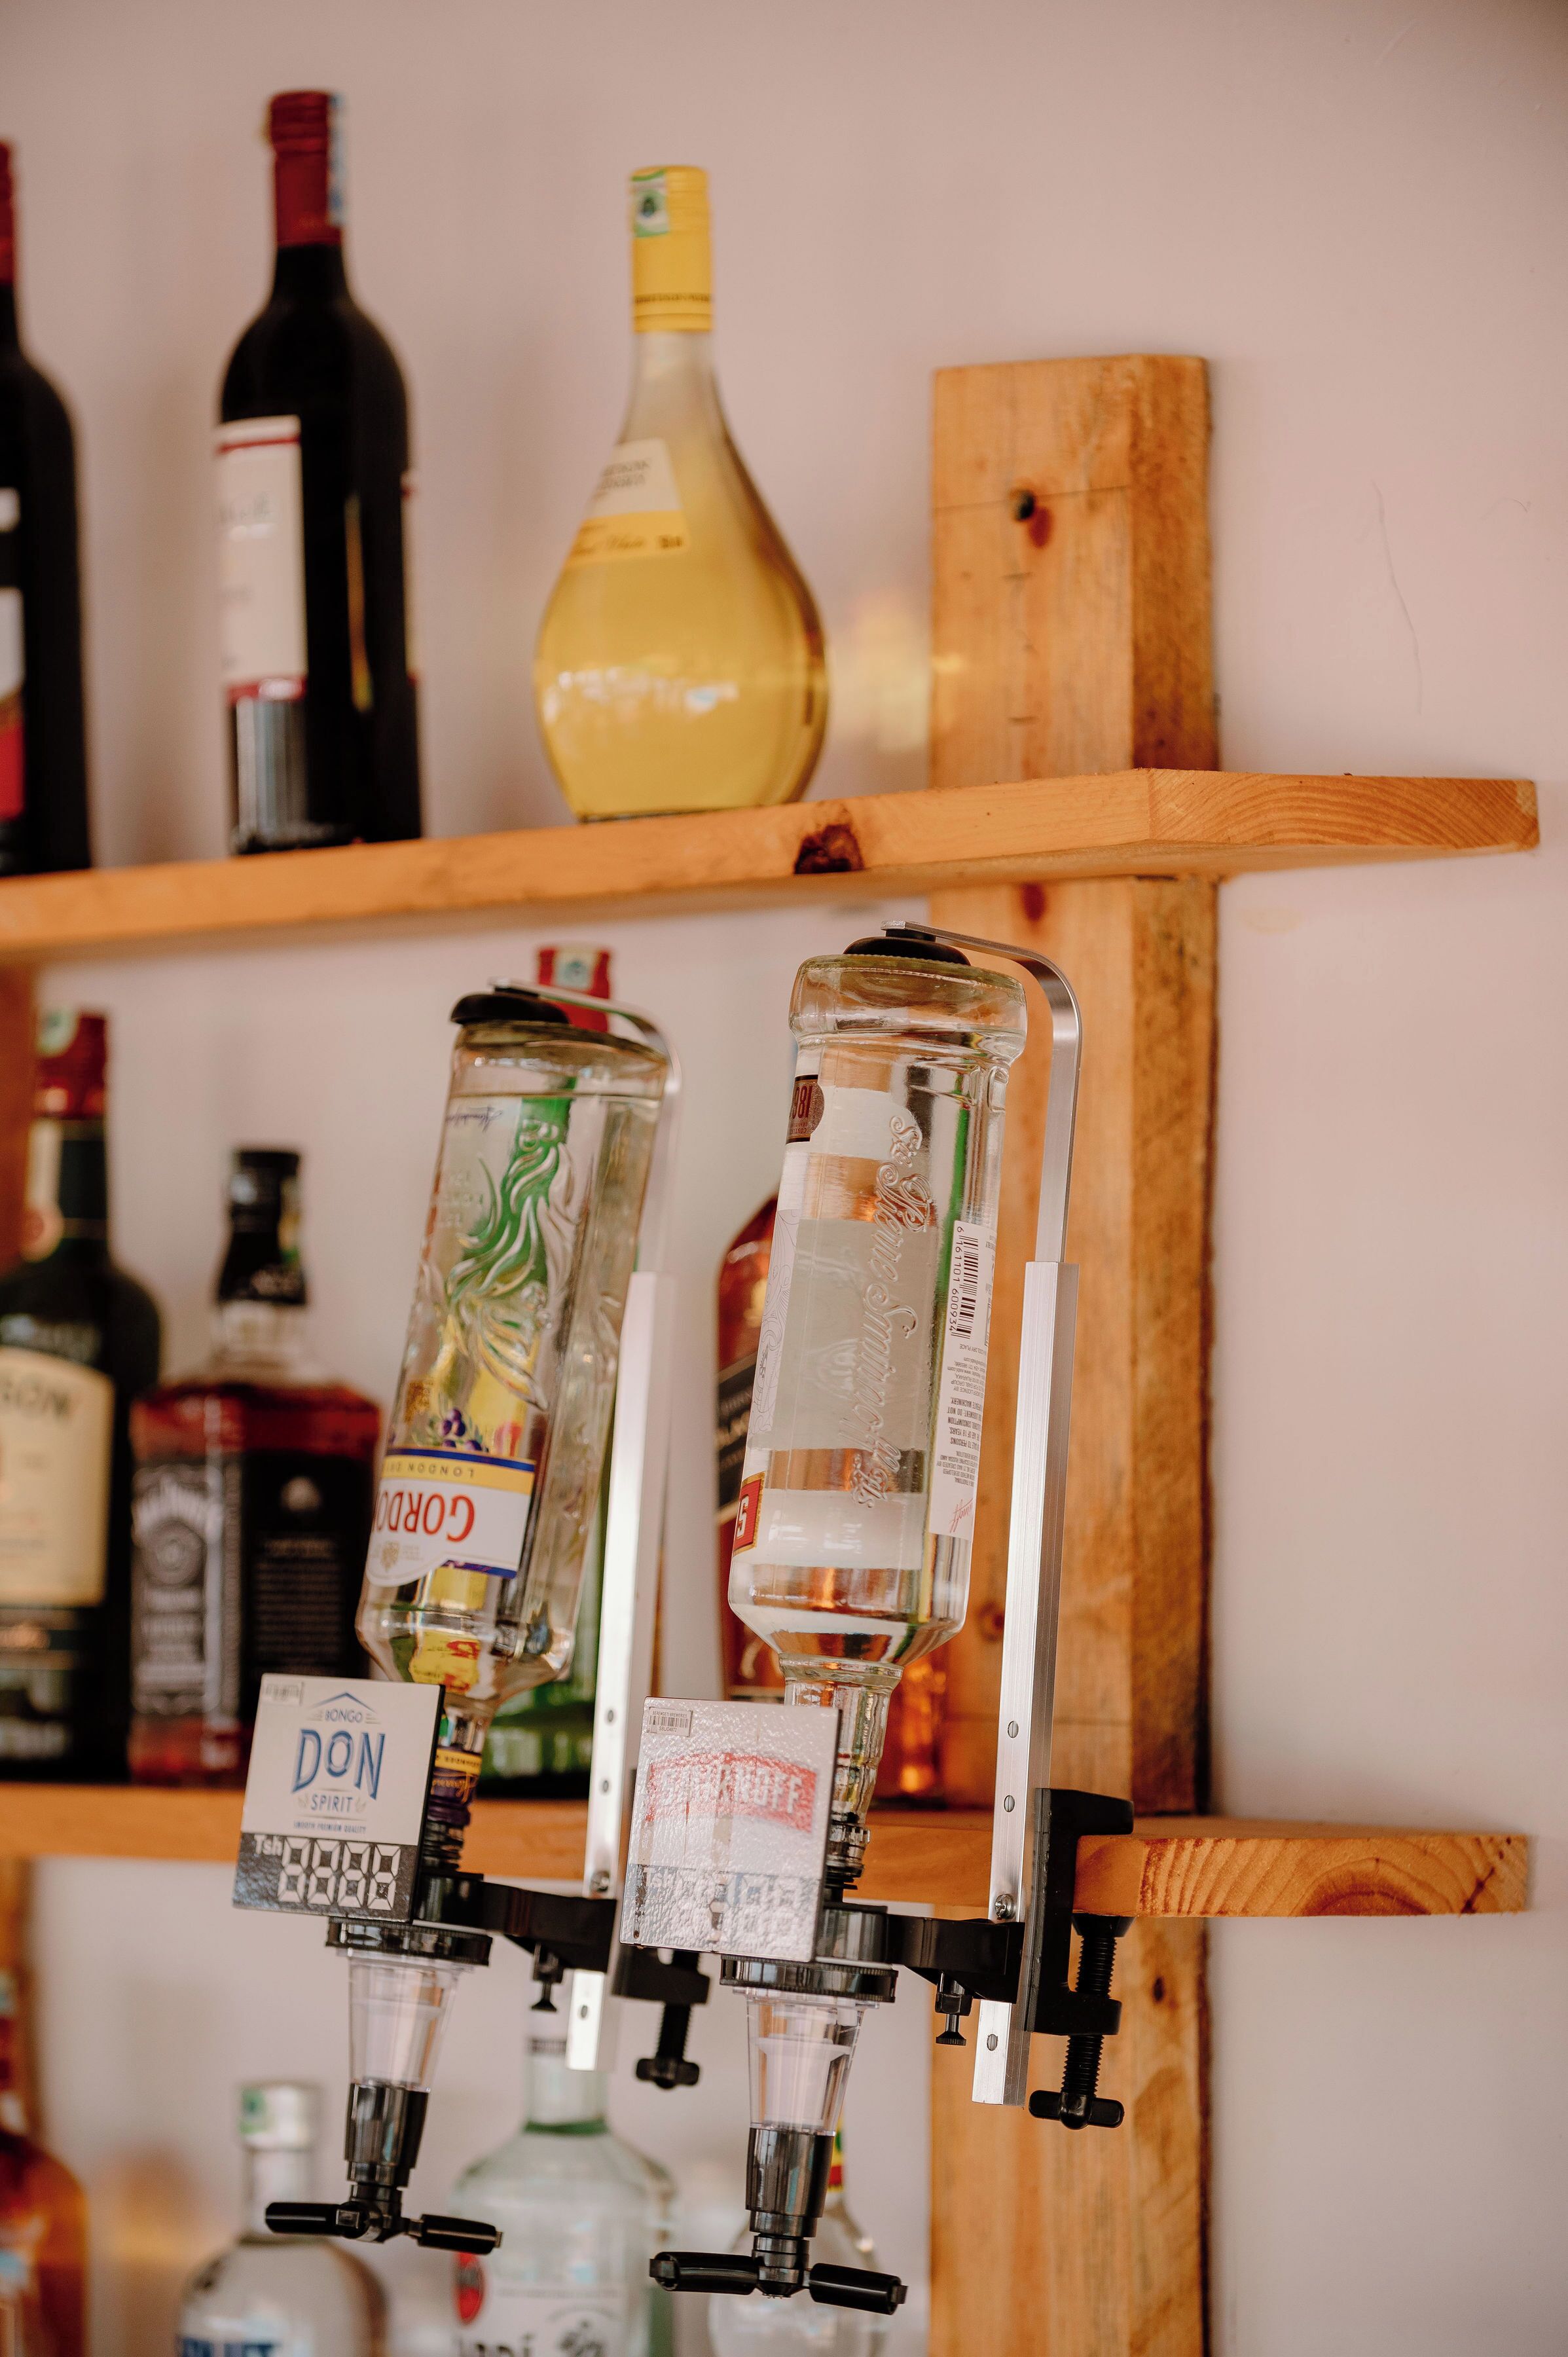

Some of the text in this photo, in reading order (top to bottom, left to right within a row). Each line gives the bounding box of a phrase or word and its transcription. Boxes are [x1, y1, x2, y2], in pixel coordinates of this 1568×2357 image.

[953, 1240, 963, 1282] 161101
[949, 1288, 959, 1332] 600934
[947, 1406, 957, 1414] NOT
[407, 1463, 475, 1478] LONDON
[325, 1708, 363, 1723] BONGO
[291, 1728, 386, 1800] DON
[311, 1793, 355, 1813] SPIRIT
[253, 1835, 283, 1857] Tsh
